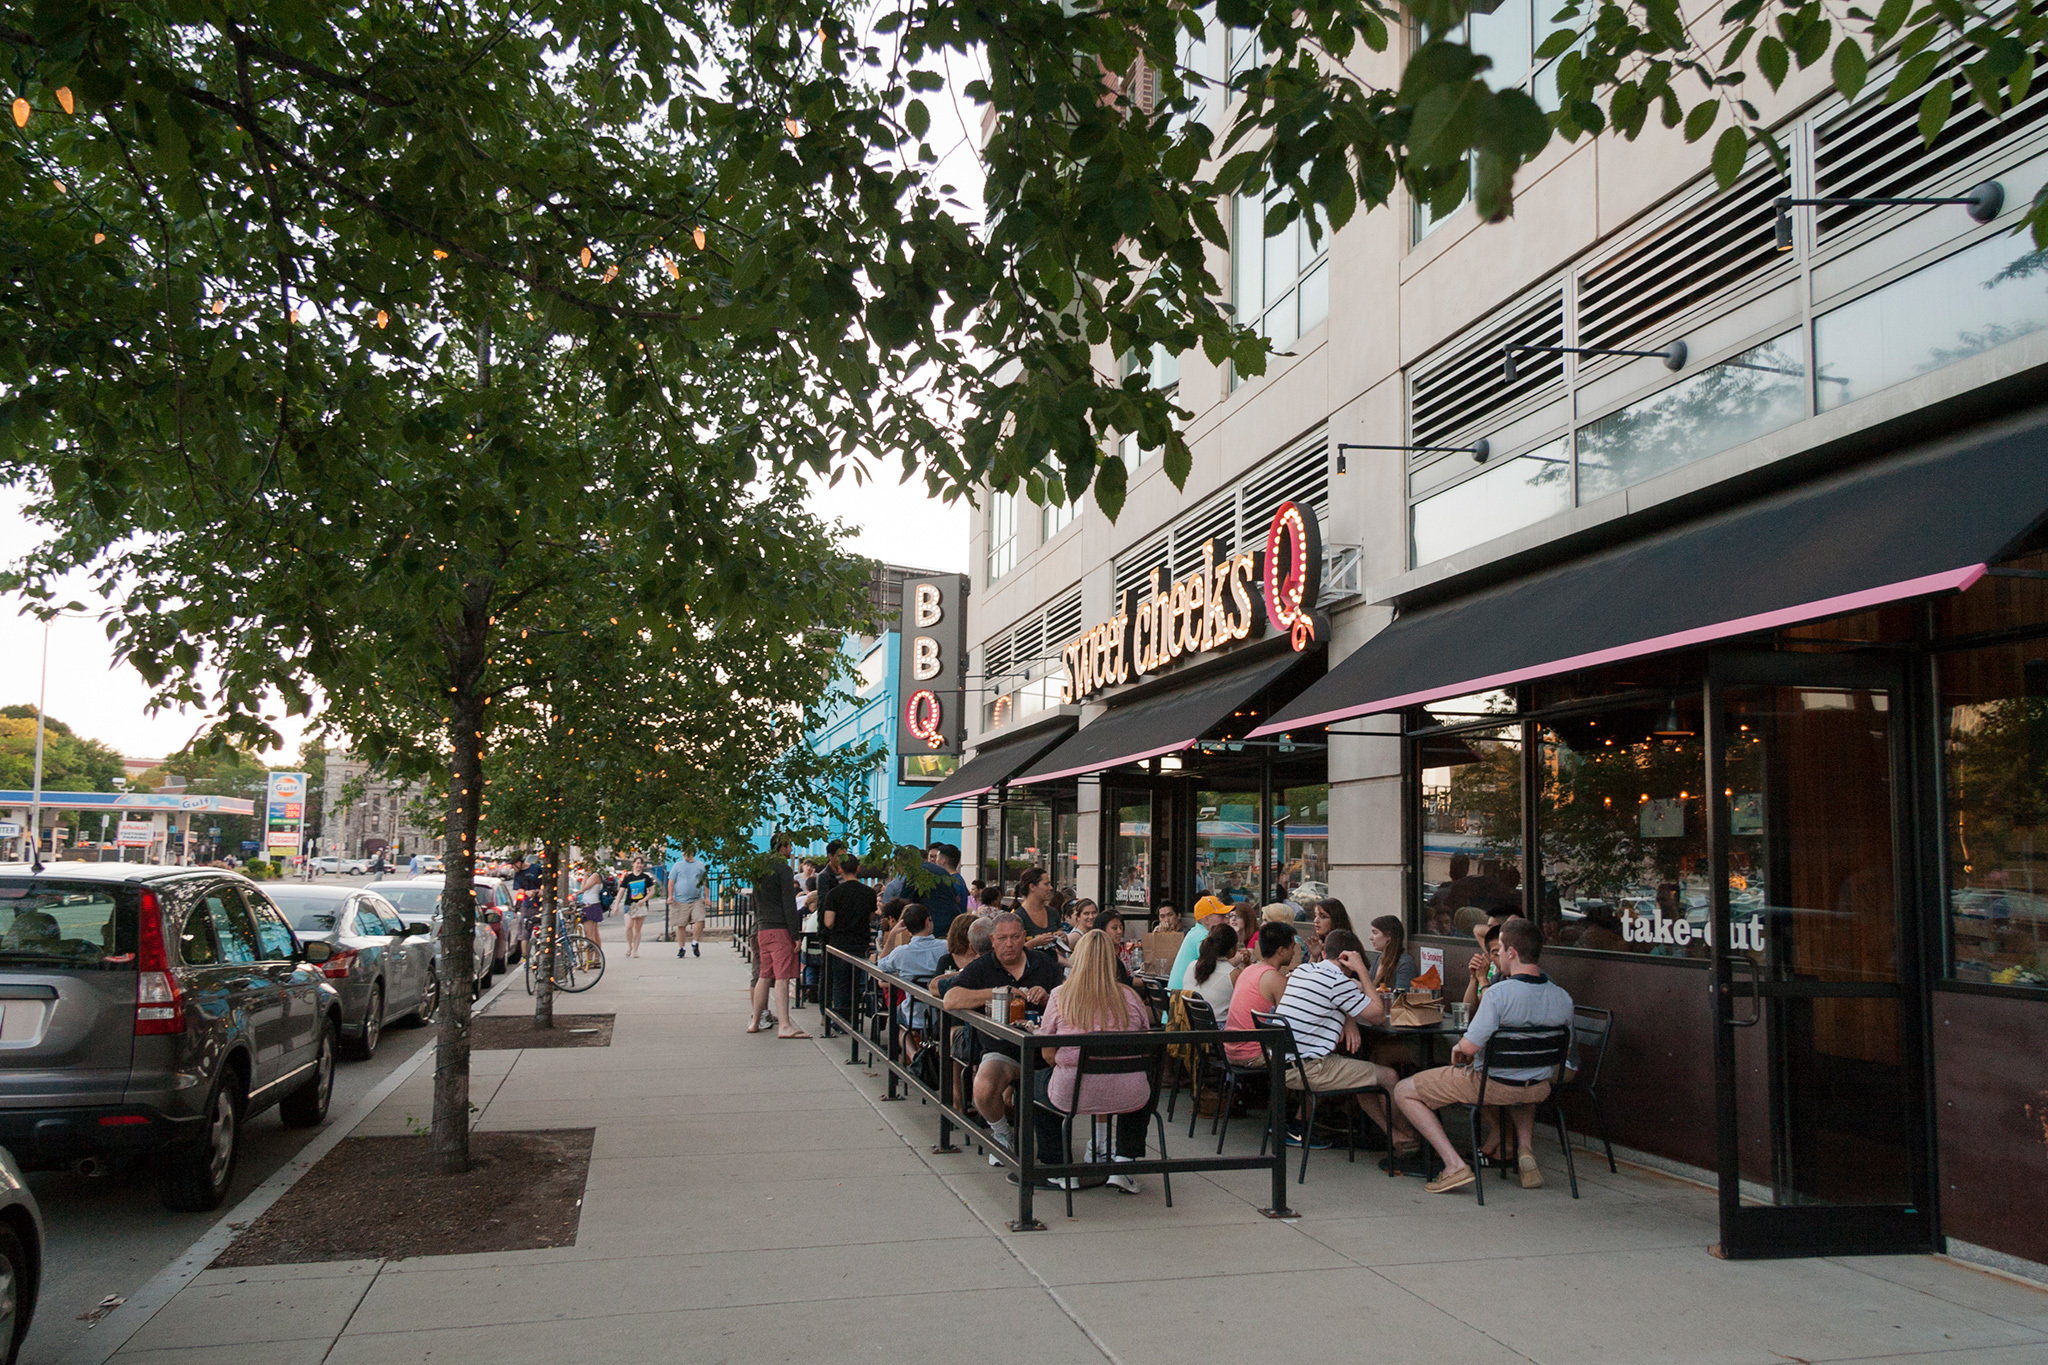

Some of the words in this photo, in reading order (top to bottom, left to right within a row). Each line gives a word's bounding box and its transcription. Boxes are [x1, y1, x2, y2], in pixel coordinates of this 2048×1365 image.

[1060, 588, 1130, 705] sweet
[1133, 537, 1256, 677] cheeks
[1264, 501, 1316, 653] Q
[905, 583, 945, 749] BBQ
[275, 783, 298, 791] Gulf
[182, 797, 209, 809] Gulf
[1428, 952, 1443, 965] Smoking
